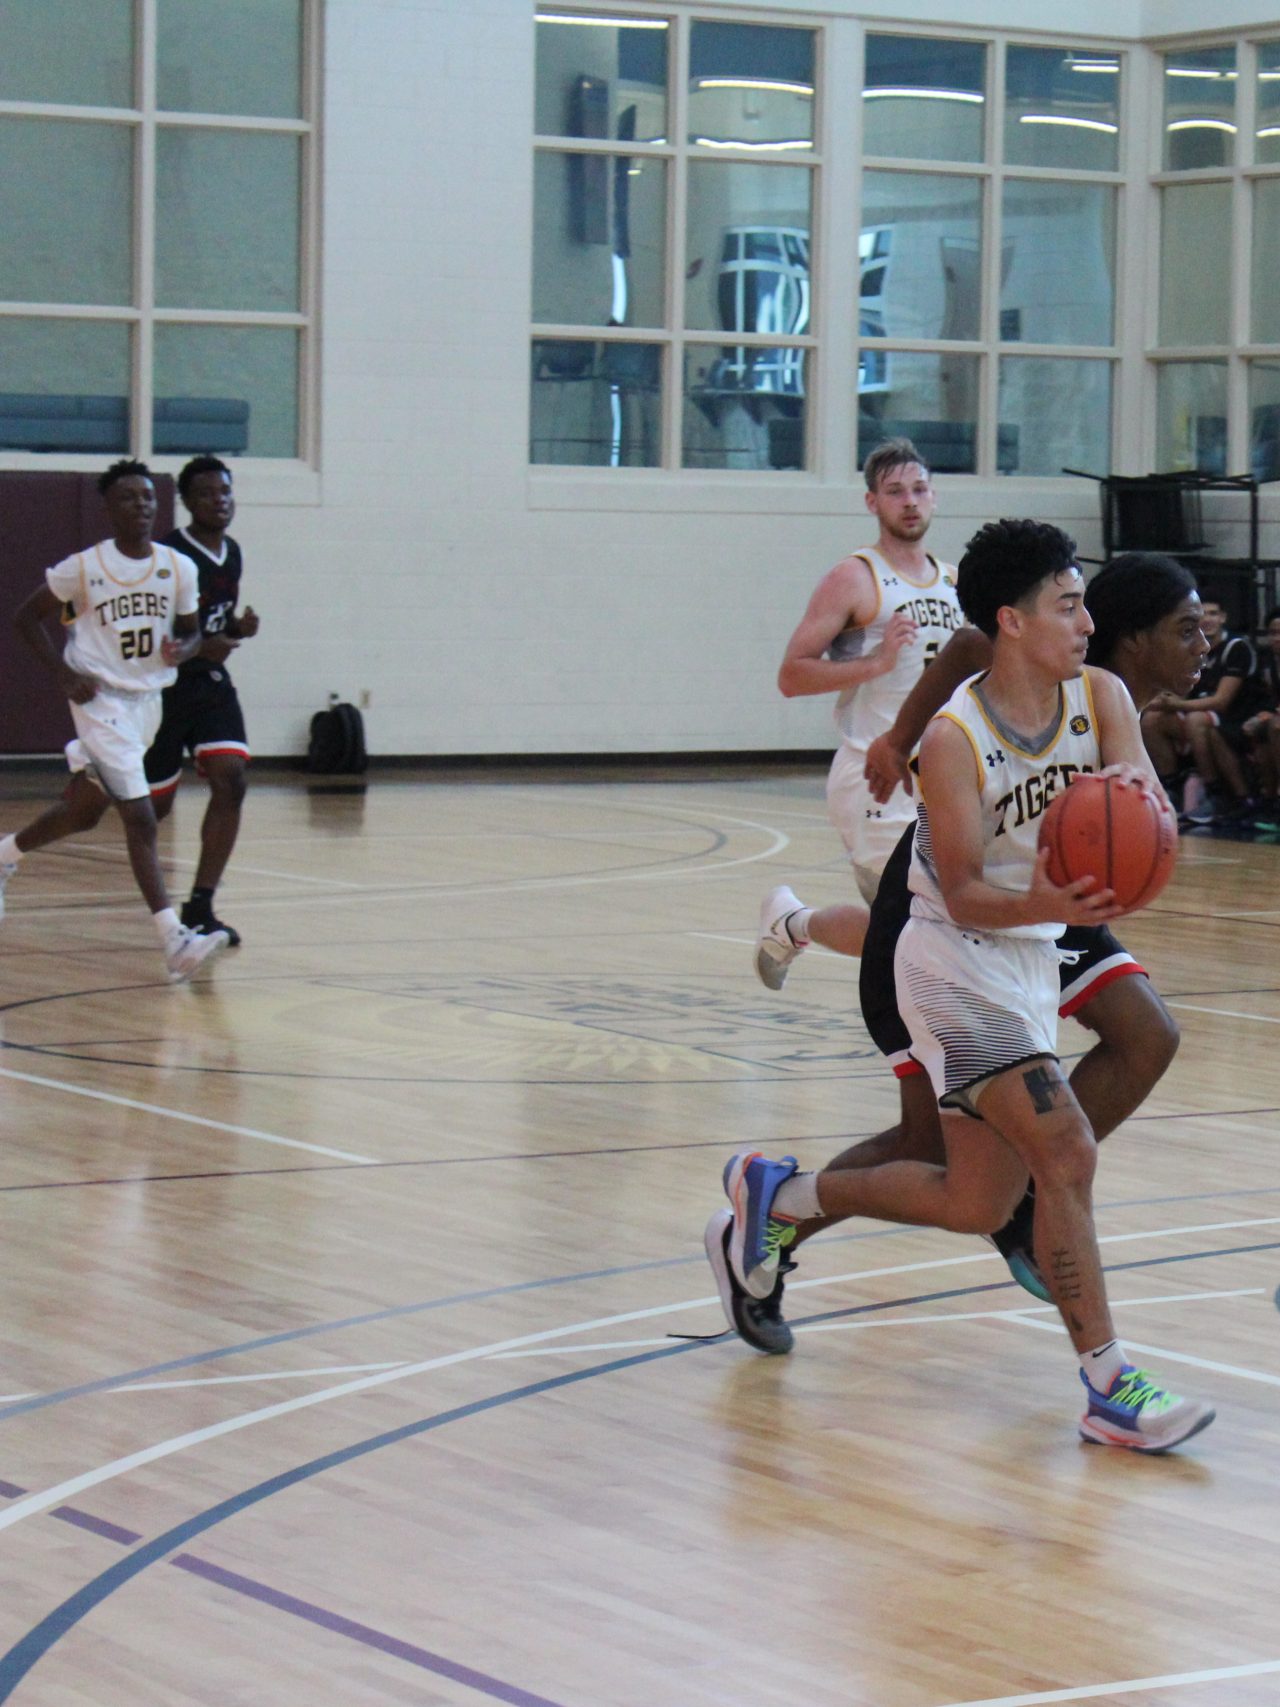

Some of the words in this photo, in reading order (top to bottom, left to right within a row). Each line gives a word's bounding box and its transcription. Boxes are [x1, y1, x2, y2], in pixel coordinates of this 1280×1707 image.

[95, 592, 168, 626] TIGERS
[120, 627, 154, 660] 20
[995, 764, 1094, 837] TIGE
